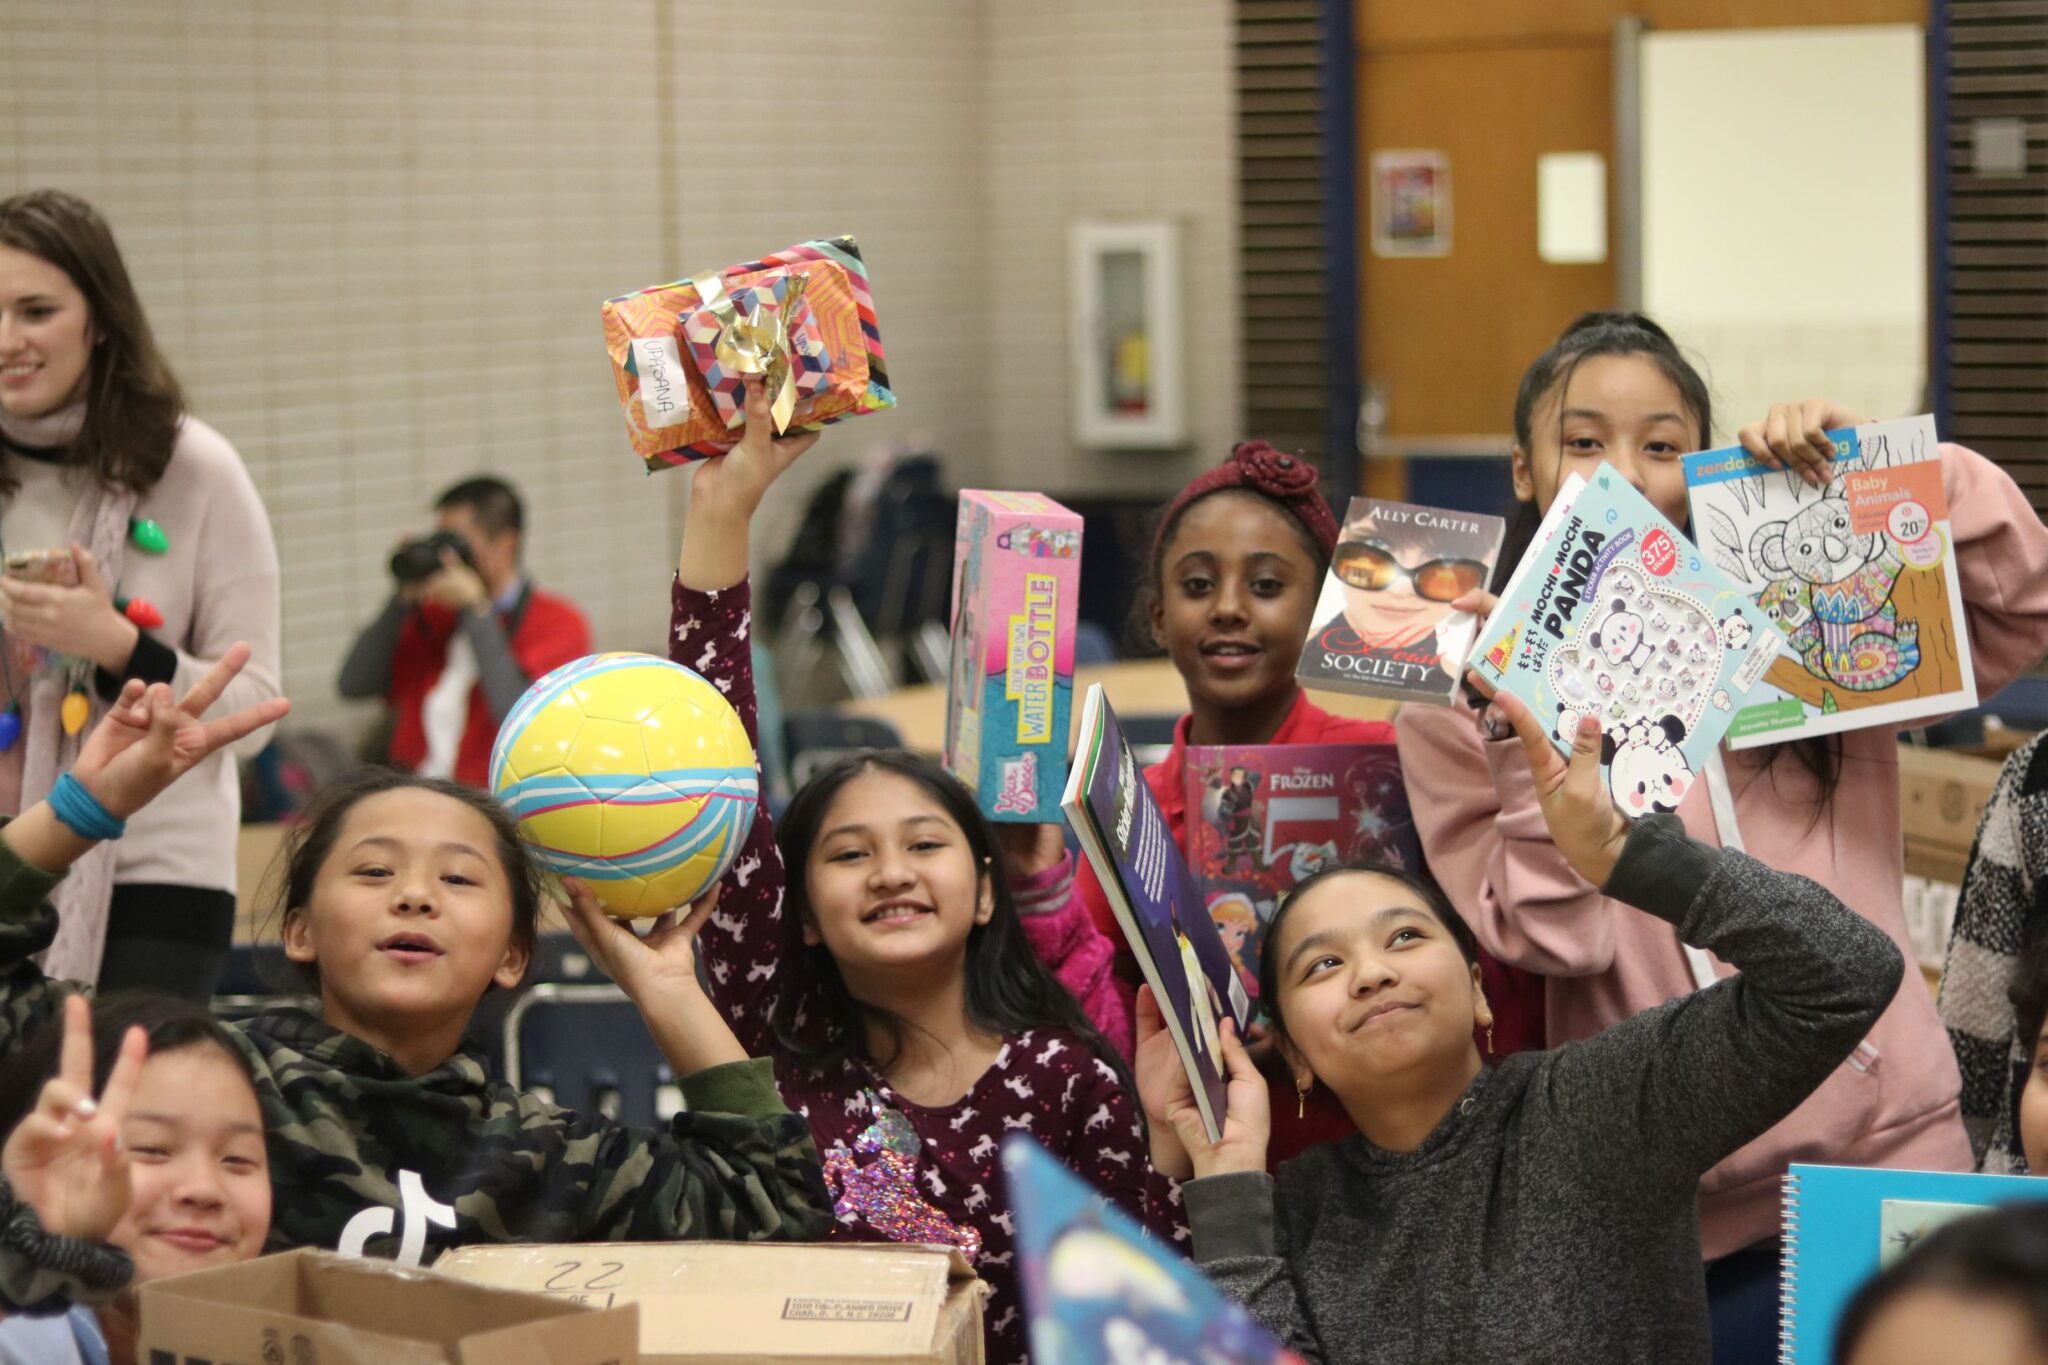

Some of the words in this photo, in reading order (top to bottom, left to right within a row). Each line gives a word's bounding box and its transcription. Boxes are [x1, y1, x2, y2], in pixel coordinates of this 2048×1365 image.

[643, 340, 675, 413] UPASANA
[1852, 474, 1888, 492] Baby
[1855, 488, 1911, 508] Animals
[1369, 505, 1410, 525] ALLY
[1414, 510, 1480, 534] CARTER
[1900, 521, 1919, 538] 20
[1642, 535, 1671, 566] 375
[1652, 549, 1675, 571] stickers
[1531, 574, 1558, 625] MOCHI
[1555, 516, 1583, 567] MOCHI
[1585, 573, 1596, 600] STICKER
[1595, 546, 1615, 573] ACTIVITY
[1614, 532, 1632, 547] BOOK
[1544, 530, 1606, 640] PANDA
[1026, 580, 1054, 681] BOTTLE
[1321, 652, 1437, 682] SOCIETY
[1023, 683, 1047, 738] WATER
[1270, 773, 1335, 792] FROZEN
[545, 1262, 624, 1290] 22
